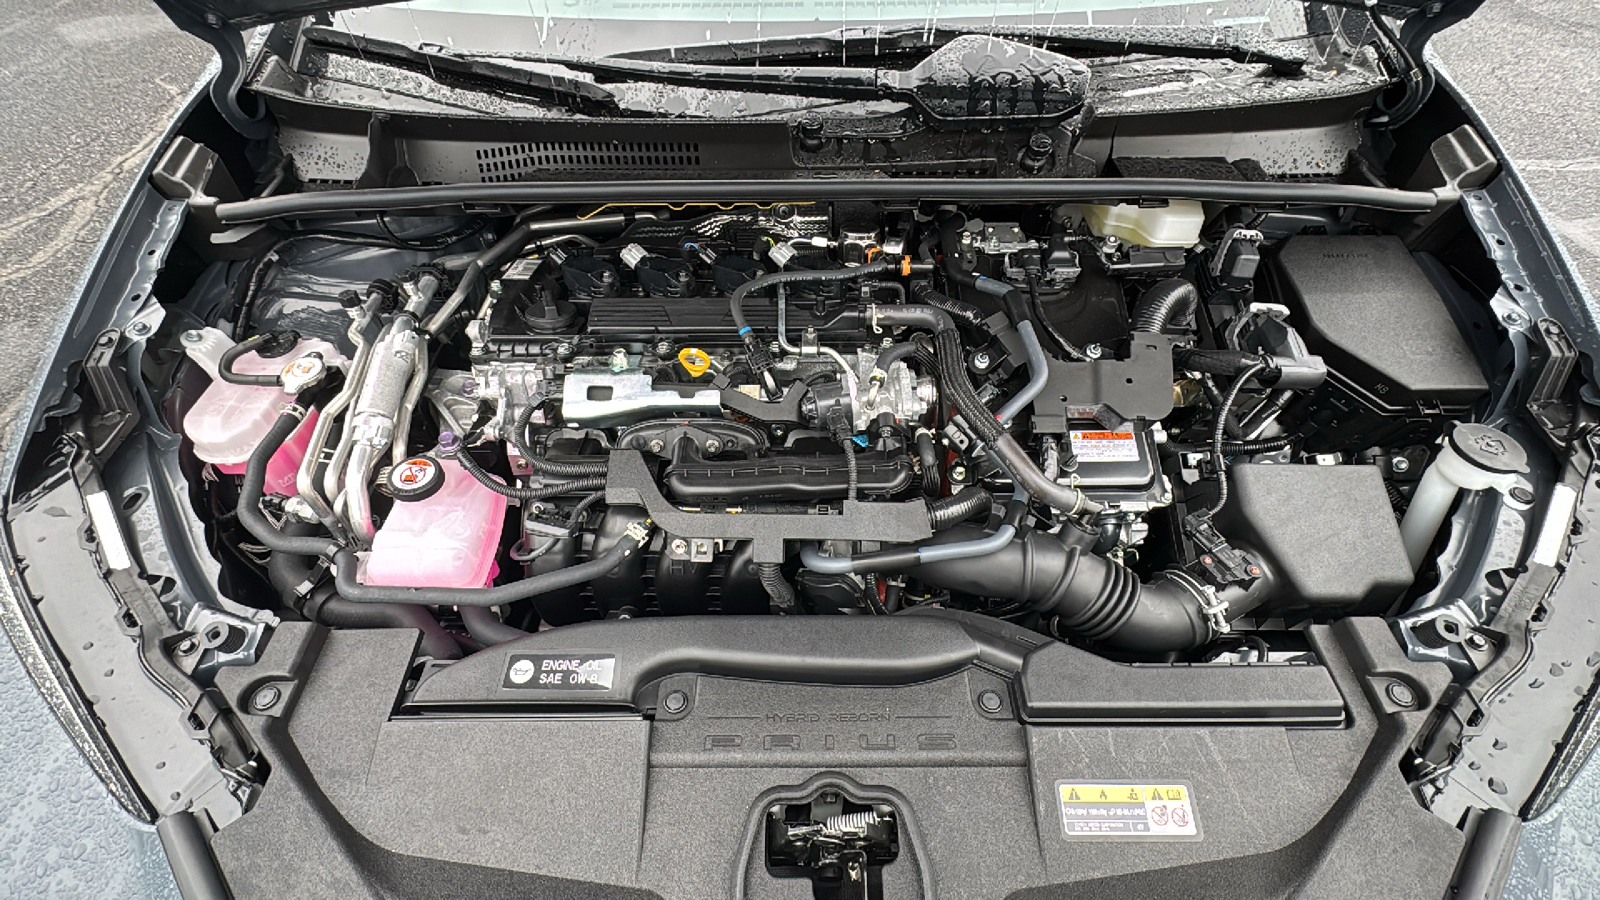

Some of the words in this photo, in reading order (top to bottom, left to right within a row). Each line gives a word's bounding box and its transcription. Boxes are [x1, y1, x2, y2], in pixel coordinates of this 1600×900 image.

[541, 659, 580, 671] ENGINE
[586, 659, 603, 671] OIL
[539, 672, 563, 684] SAE
[765, 713, 821, 723] HYBRID
[828, 713, 891, 723] REBORN
[704, 734, 957, 751] PRIUS
